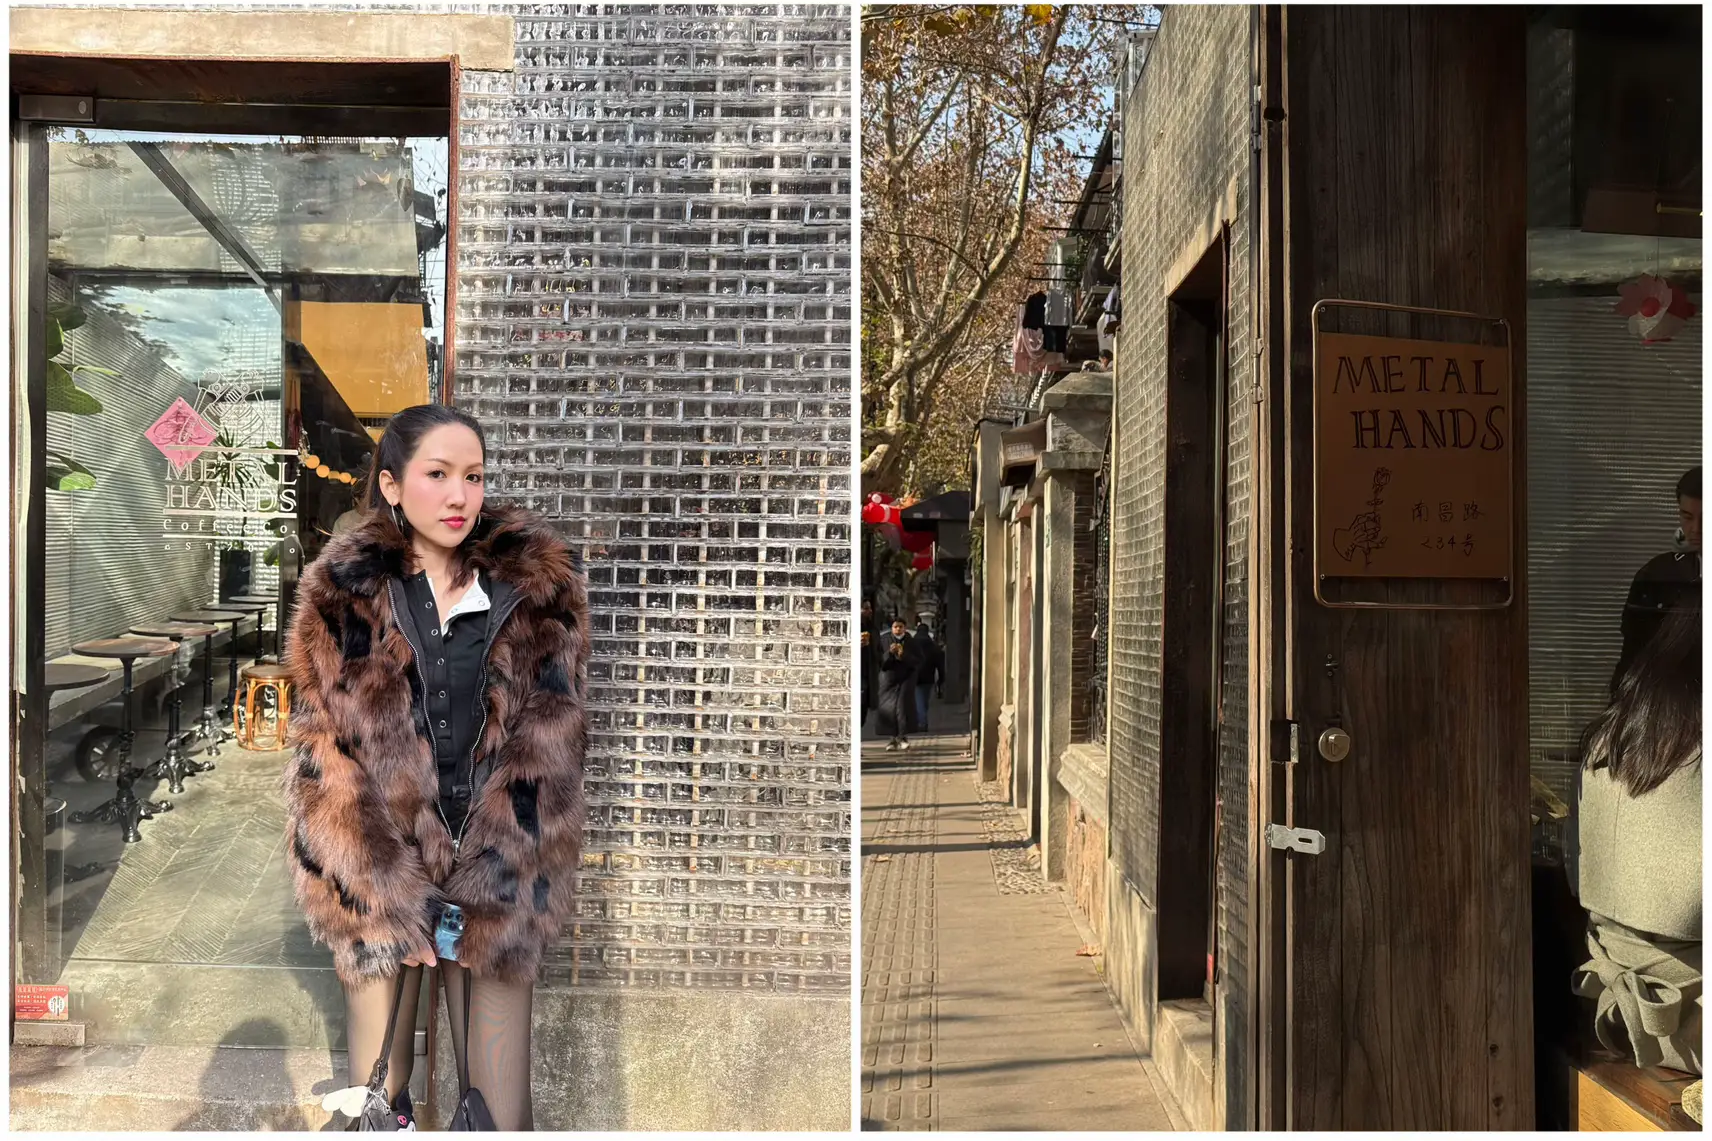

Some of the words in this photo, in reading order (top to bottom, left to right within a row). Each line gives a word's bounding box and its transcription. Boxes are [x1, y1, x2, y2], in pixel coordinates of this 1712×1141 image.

[1332, 354, 1500, 396] METAL
[1349, 405, 1506, 452] HANDS
[164, 457, 298, 486] METAL
[164, 485, 298, 513] HANDS
[1412, 499, 1486, 524] 南昌路
[1420, 533, 1477, 558] 234号
